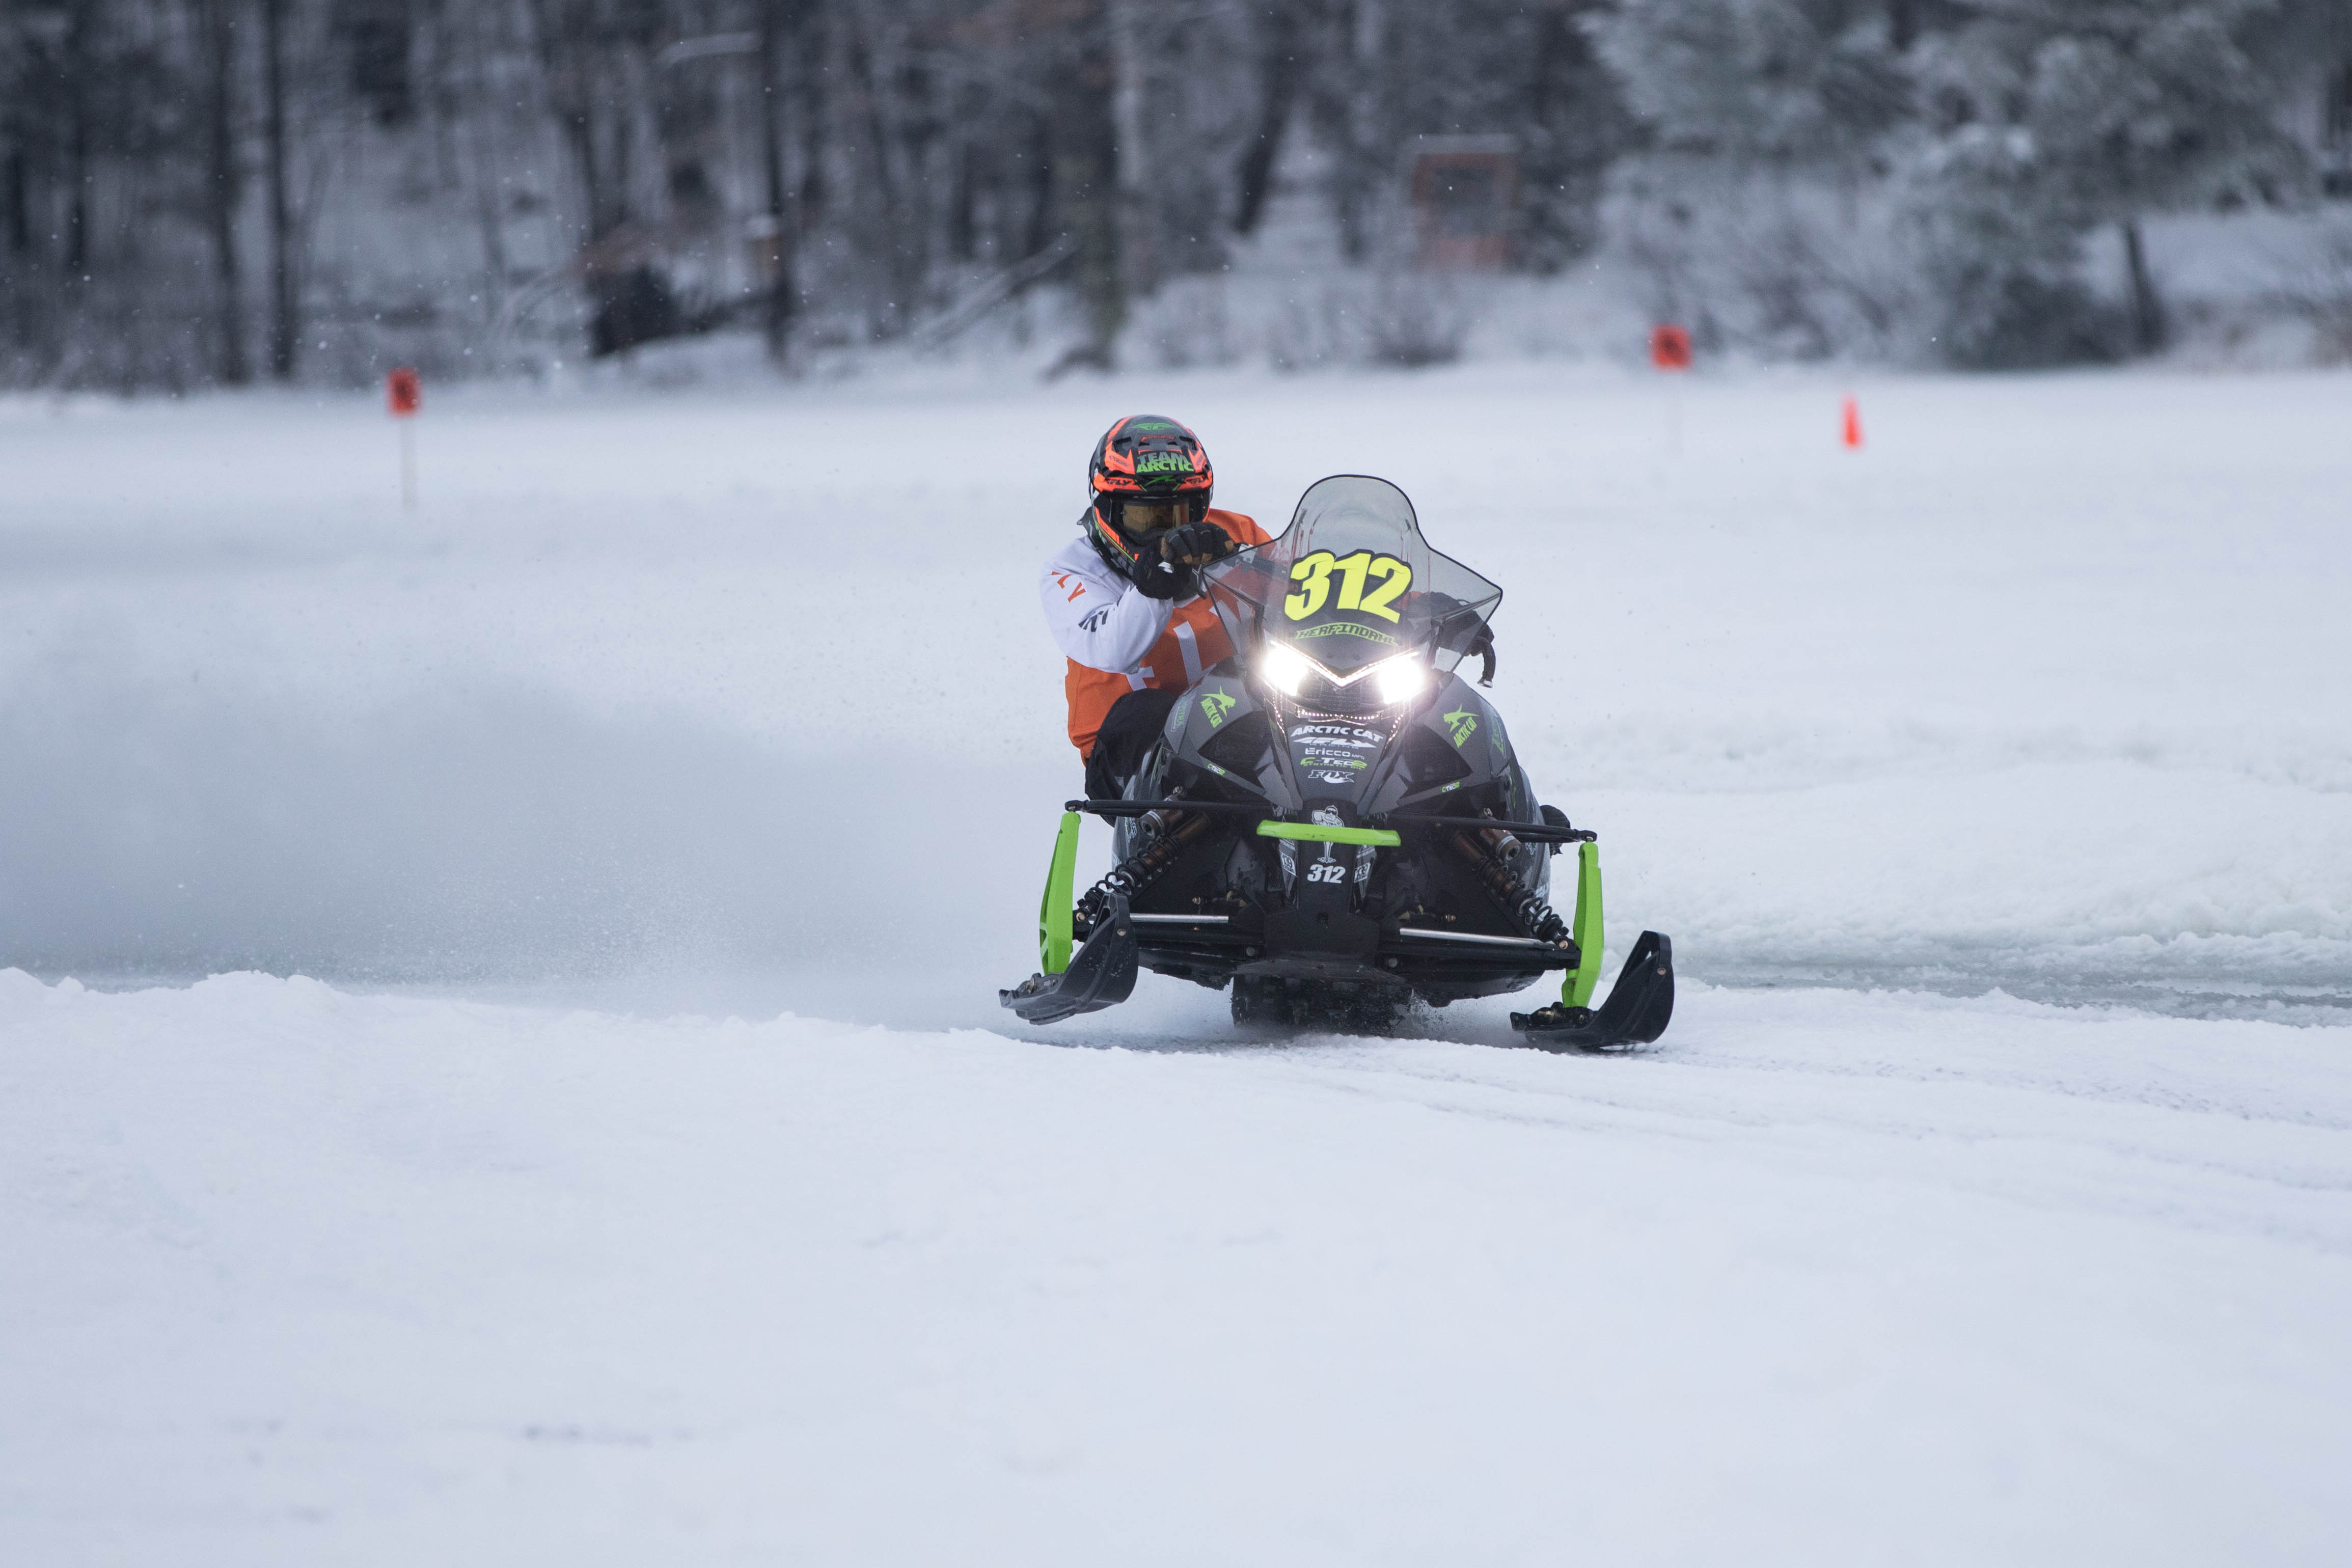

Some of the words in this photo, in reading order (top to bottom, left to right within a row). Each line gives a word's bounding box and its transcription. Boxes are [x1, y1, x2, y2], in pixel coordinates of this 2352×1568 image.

[1136, 460, 1194, 473] ARCTIC
[1137, 452, 1191, 464] TEAM
[1284, 553, 1411, 624] 312
[1297, 623, 1399, 646] HERFINDAHL
[1200, 697, 1218, 720] ARCTIC
[1210, 713, 1223, 729] CAT
[1291, 725, 1351, 737] ARCTIC
[1353, 729, 1384, 742] CAT
[1453, 724, 1471, 749] ARCTIC
[1466, 716, 1477, 732] CAT
[1305, 748, 1351, 757] Ericco
[1308, 769, 1355, 784] FOX
[1307, 864, 1346, 884] 312
